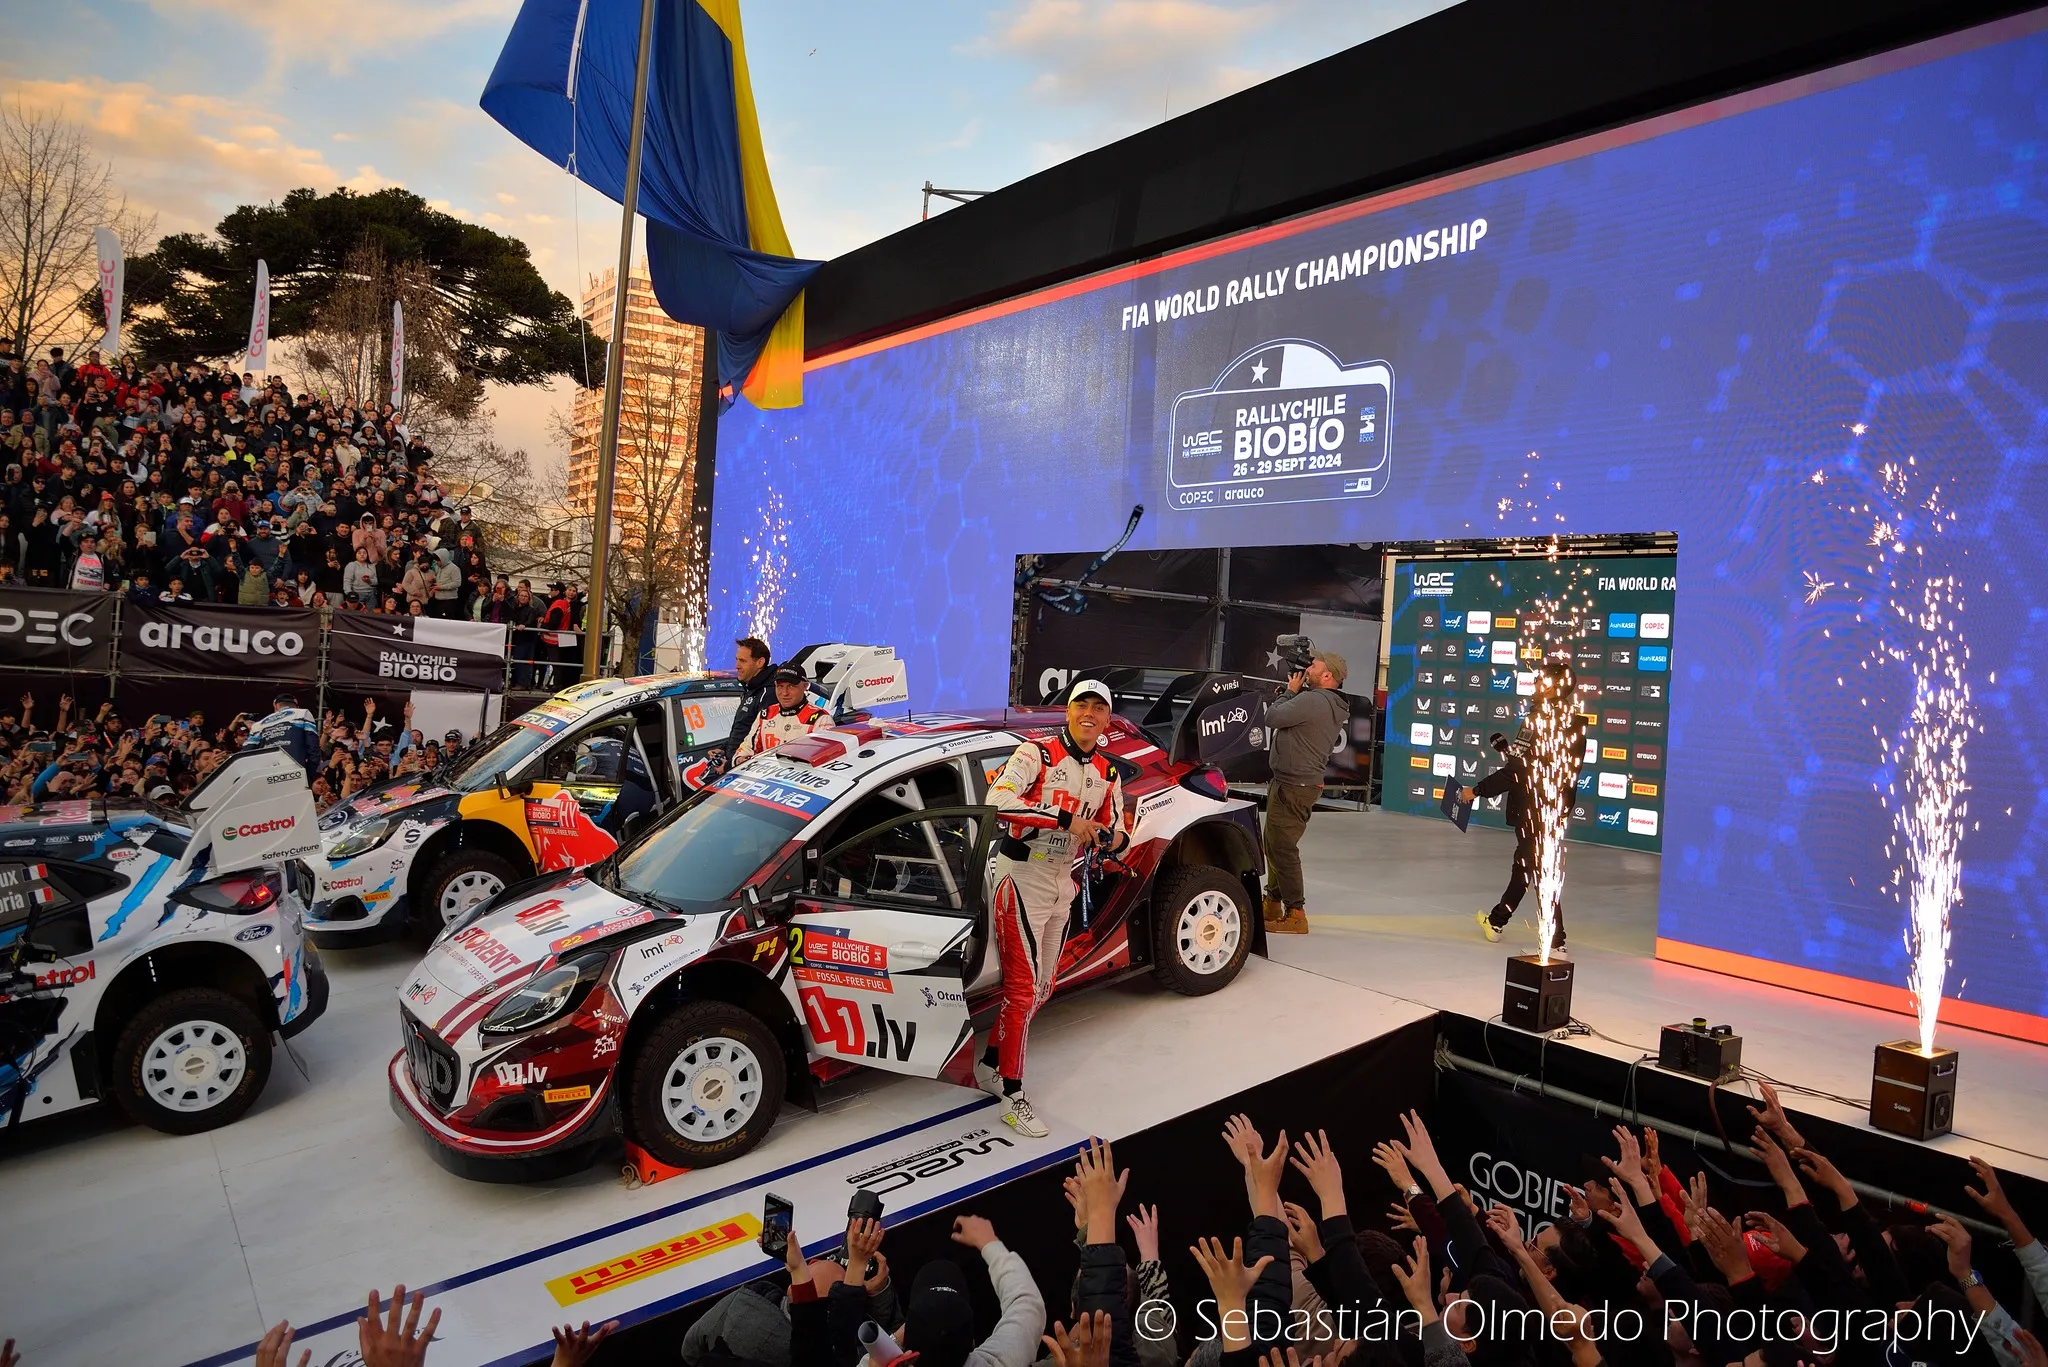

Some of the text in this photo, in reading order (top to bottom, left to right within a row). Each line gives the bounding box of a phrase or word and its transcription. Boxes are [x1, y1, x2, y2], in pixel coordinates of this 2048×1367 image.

[1122, 218, 1488, 330] FIA WORLD RALLY CHAMPIONSHIP
[1235, 393, 1347, 428] RALLYCHILE
[1183, 429, 1223, 448] WRC
[1233, 462, 1248, 477] 26
[1257, 460, 1272, 474] 29
[1274, 456, 1307, 473] SEPT
[1309, 453, 1342, 470] 2024
[1180, 487, 1265, 504] COPEC arauco
[1414, 572, 1454, 586] WRC
[1598, 577, 1616, 591] FIA
[1618, 577, 1658, 591] WORLD
[139, 621, 304, 656] arauco
[380, 651, 458, 667] RALLYCHILE
[864, 675, 895, 687] Castrol
[876, 693, 907, 703] SafetyCulture
[683, 704, 706, 731] 13
[1201, 714, 1226, 737] lmt
[1606, 717, 1627, 725] arauco
[1635, 720, 1662, 728] FANATEC
[266, 771, 302, 785] sparco
[741, 760, 831, 789] SafetyCulture
[724, 777, 812, 809] FORUM8
[560, 801, 579, 828] HY
[238, 815, 295, 837] Castrol
[111, 851, 133, 859] BELL
[261, 843, 320, 860] SafetyCulture
[330, 876, 364, 890] Castrol
[242, 926, 268, 941] Ford
[560, 935, 583, 949] 22
[453, 926, 522, 974] STORENT
[640, 943, 664, 960] lmt
[808, 942, 828, 951] WRC
[831, 941, 870, 953] RALLYCHILE
[816, 971, 866, 988] FOSSIL-FREE
[866, 977, 888, 991] FUEL
[483, 1024, 515, 1033] LAZER
[548, 1087, 587, 1100] PIRELLI
[662, 1130, 748, 1153] SCORPION
[856, 1137, 1015, 1195] WRC
[570, 1222, 748, 1295] PIRELLI
